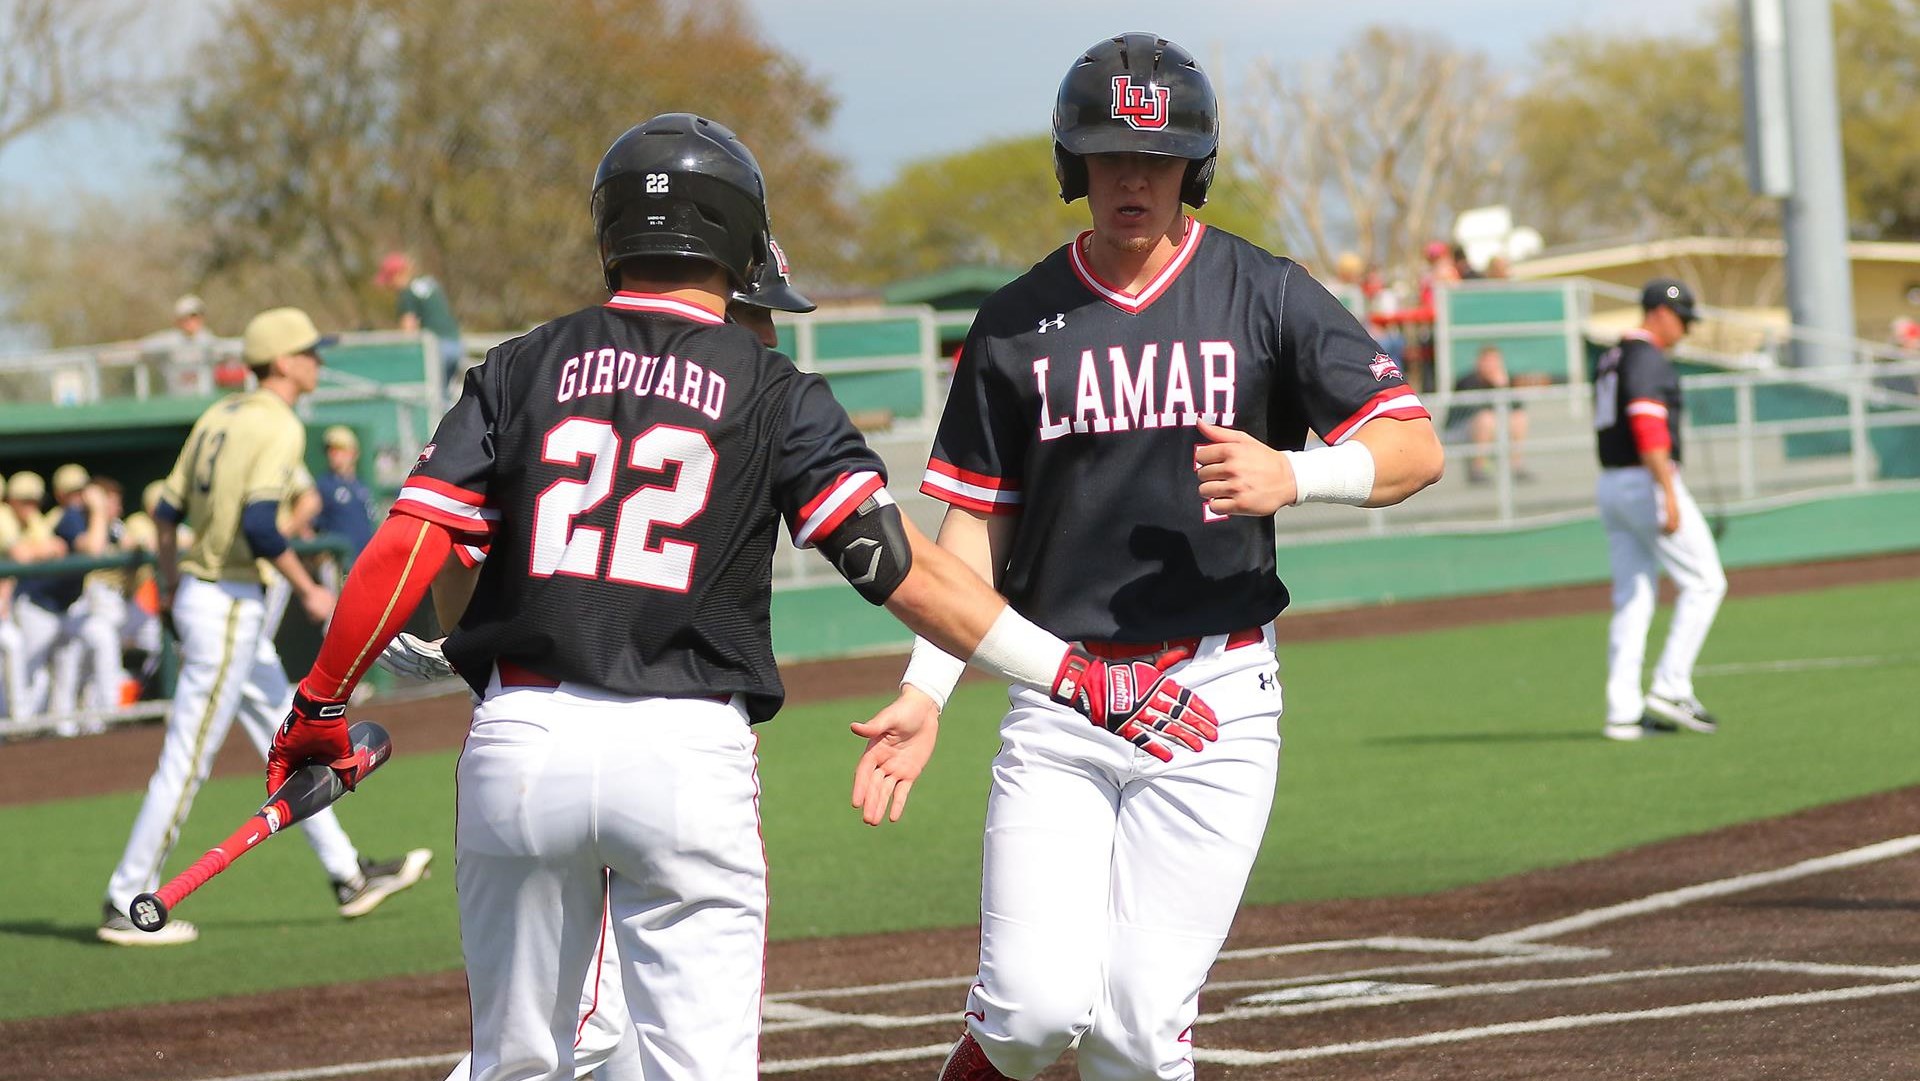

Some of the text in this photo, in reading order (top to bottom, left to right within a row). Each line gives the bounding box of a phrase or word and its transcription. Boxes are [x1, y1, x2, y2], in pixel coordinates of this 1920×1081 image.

[1111, 75, 1170, 131] LU
[645, 173, 670, 193] 22
[556, 347, 727, 421] GIROUARD
[1033, 341, 1237, 441] LAMAR
[528, 415, 719, 593] 22
